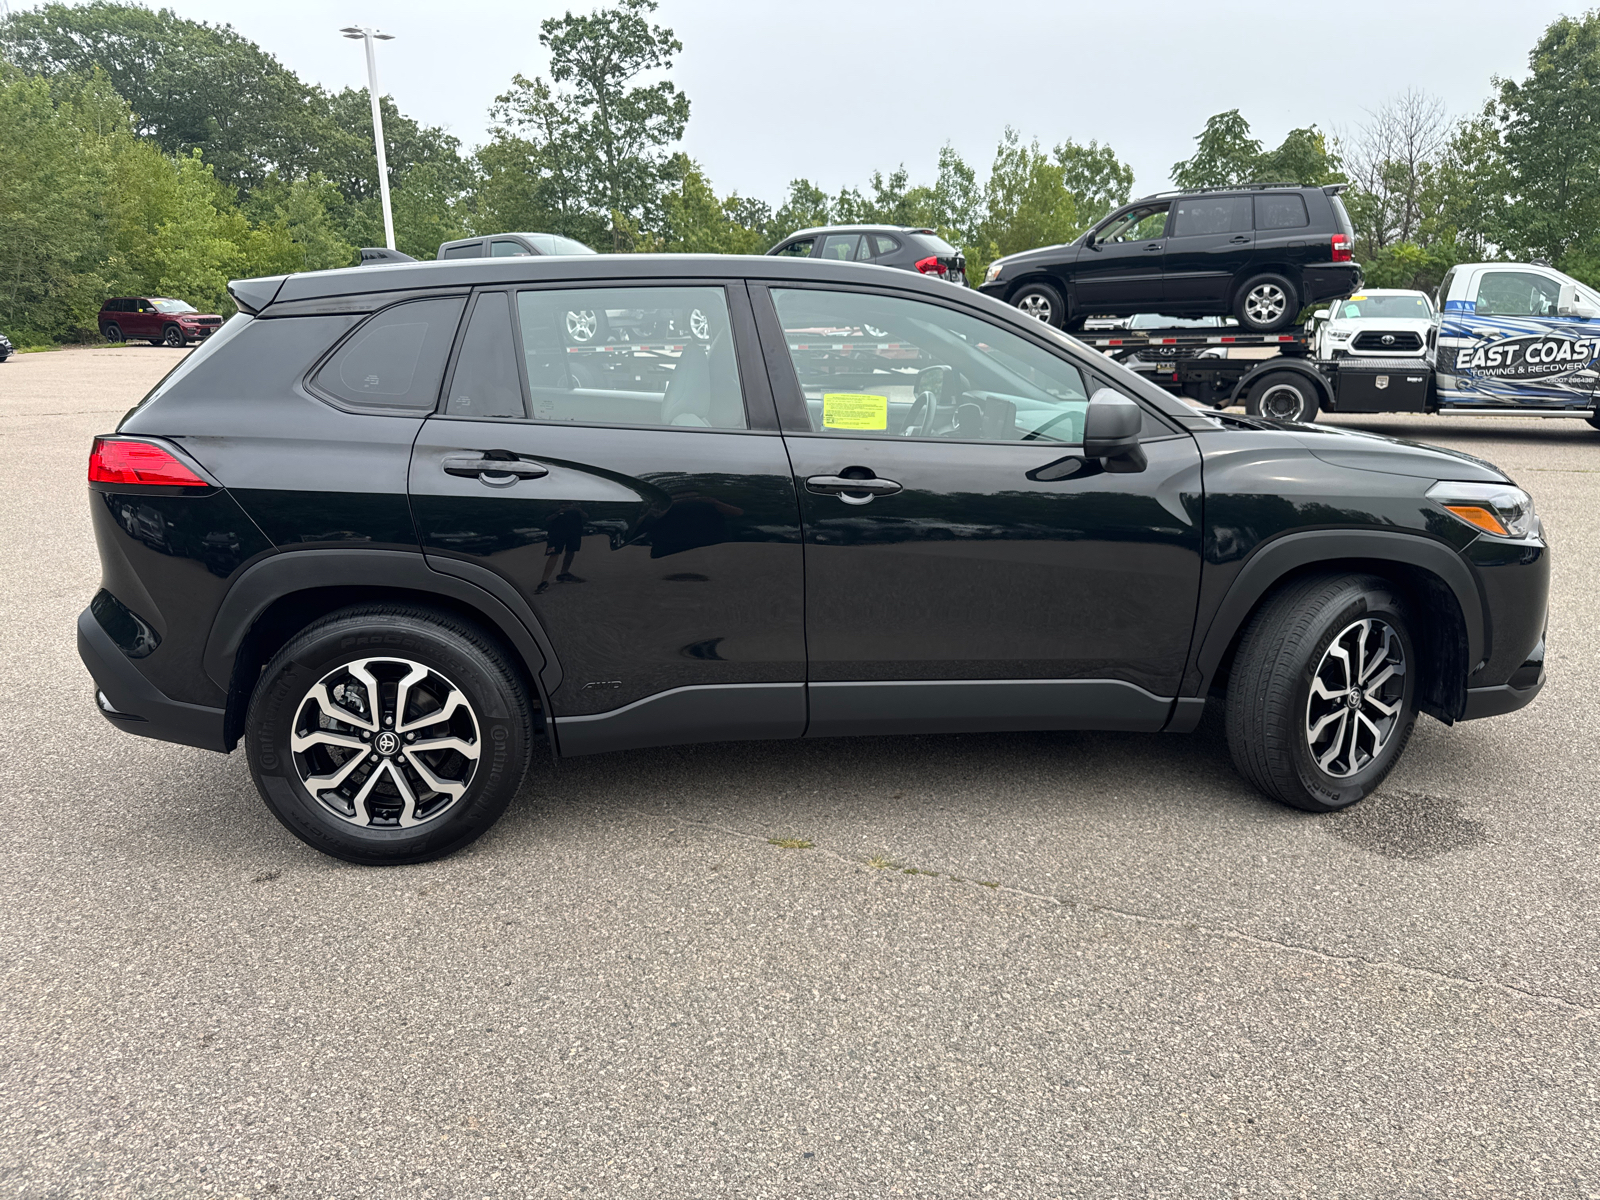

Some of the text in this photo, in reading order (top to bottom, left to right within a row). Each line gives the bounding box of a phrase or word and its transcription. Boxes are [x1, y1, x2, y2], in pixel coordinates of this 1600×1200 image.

[1456, 338, 1600, 369] EAST COAST
[1471, 362, 1590, 377] TOWING & RECOVERY
